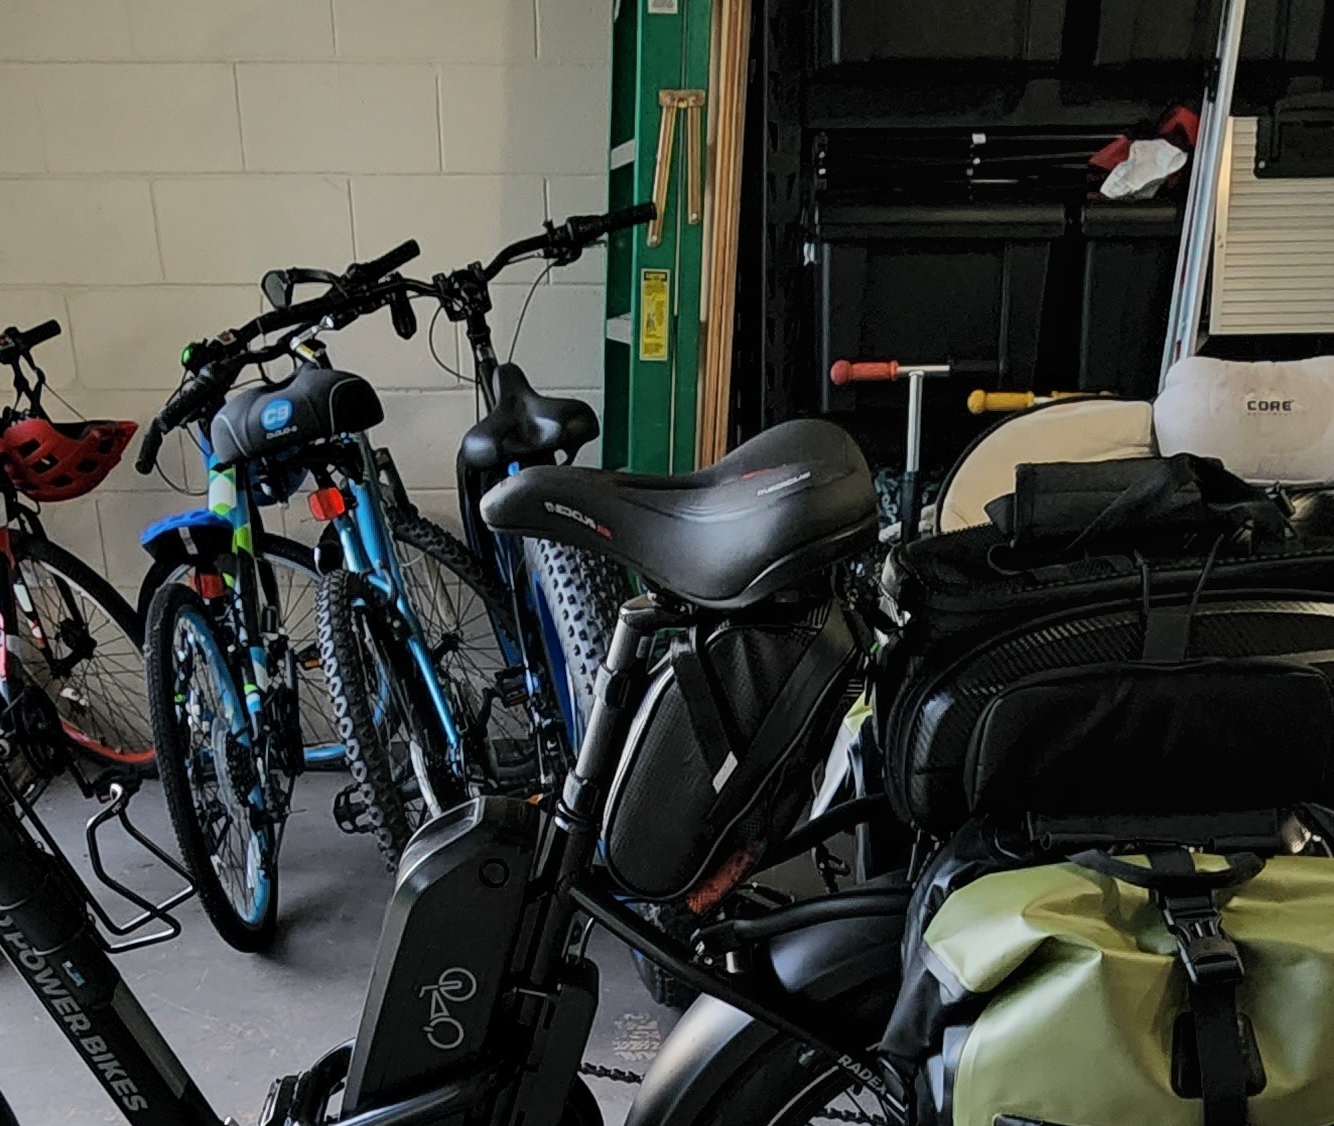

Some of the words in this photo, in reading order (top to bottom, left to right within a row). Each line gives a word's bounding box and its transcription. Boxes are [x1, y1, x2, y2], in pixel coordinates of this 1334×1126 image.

[262, 404, 289, 425] C9
[1246, 399, 1292, 412] CORE
[3, 930, 92, 1036] POWER
[79, 1033, 150, 1113] BIKES
